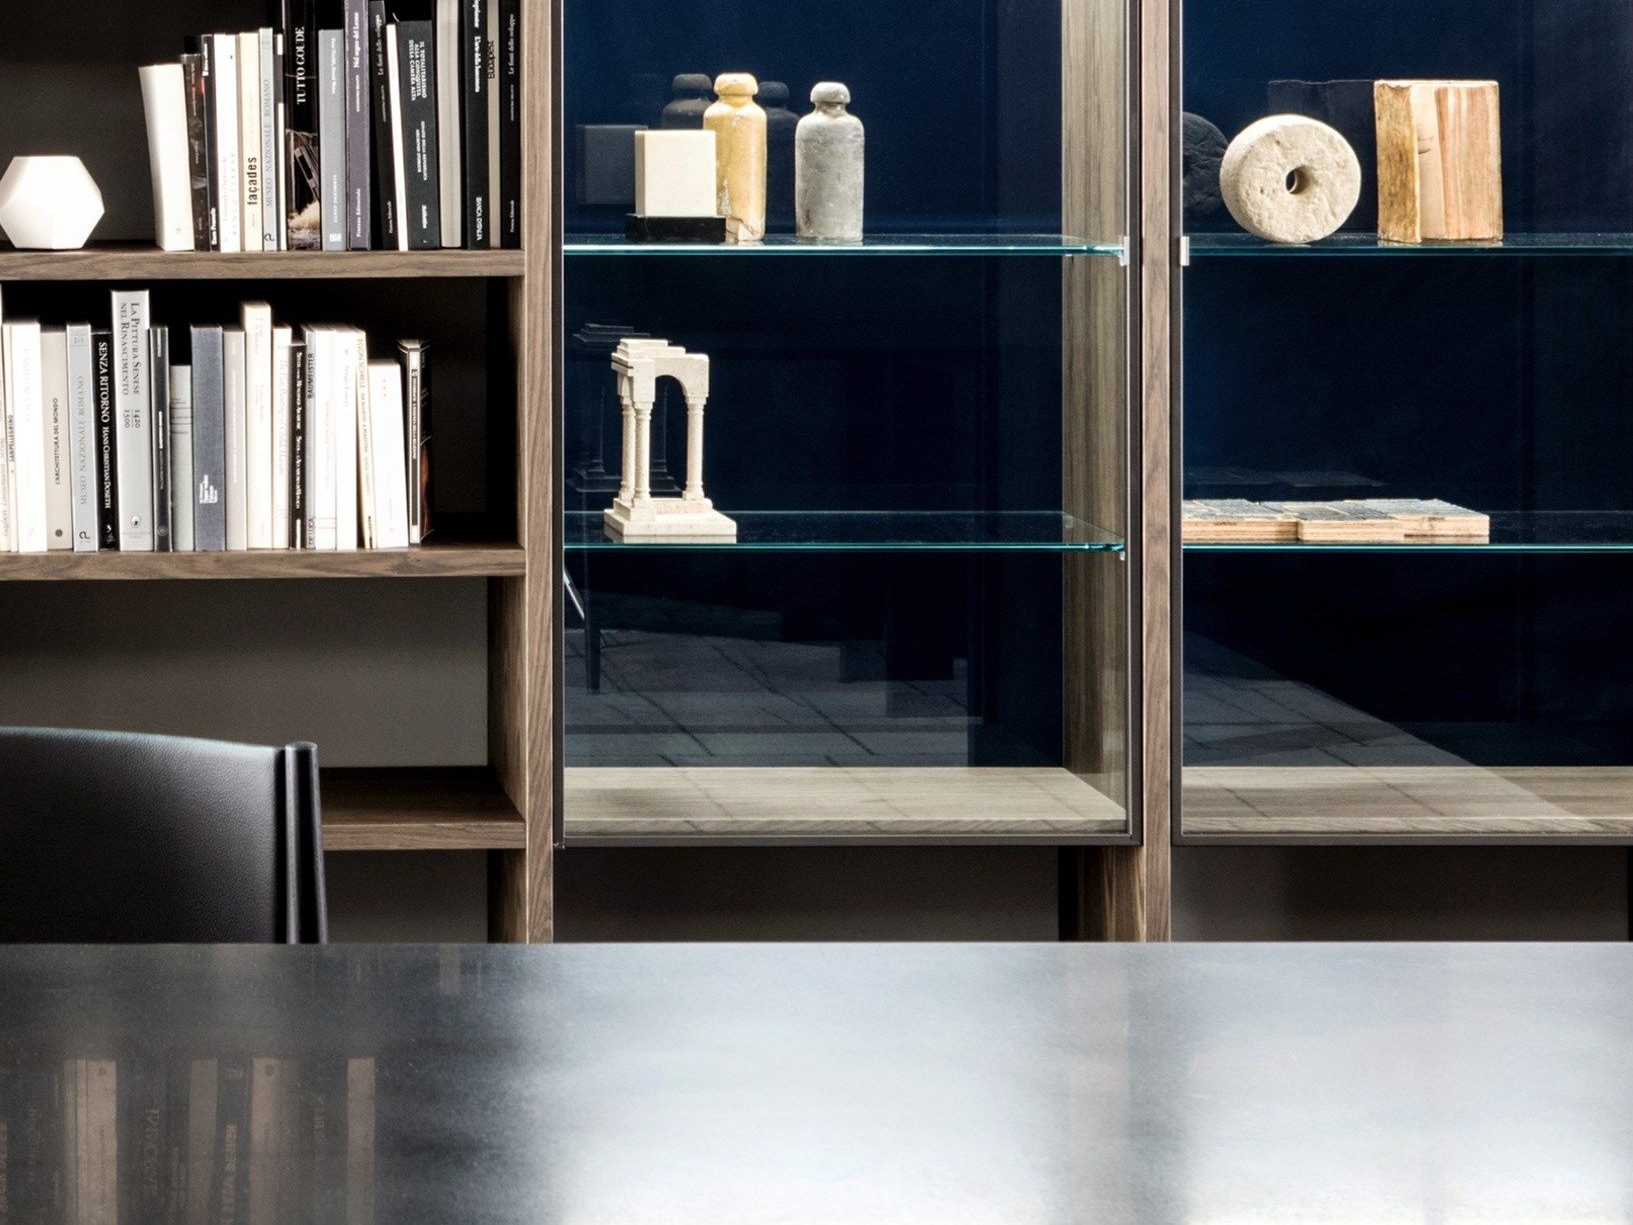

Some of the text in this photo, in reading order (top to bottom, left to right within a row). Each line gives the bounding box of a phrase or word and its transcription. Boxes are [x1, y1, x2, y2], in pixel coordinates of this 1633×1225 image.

[295, 27, 305, 104] TUTTO GOUDE
[263, 79, 271, 117] ROMANO
[264, 123, 272, 171] NAZIONALE
[247, 157, 259, 205] façades
[131, 303, 140, 315] LA
[99, 342, 108, 374] SENZA
[121, 322, 130, 395] RINASCIMENTO
[131, 318, 140, 359] PITTURA
[77, 376, 85, 416] ROMANO
[100, 376, 110, 422] RITORNO
[132, 362, 140, 395] SENESE
[79, 422, 87, 471] NAZIONALE
